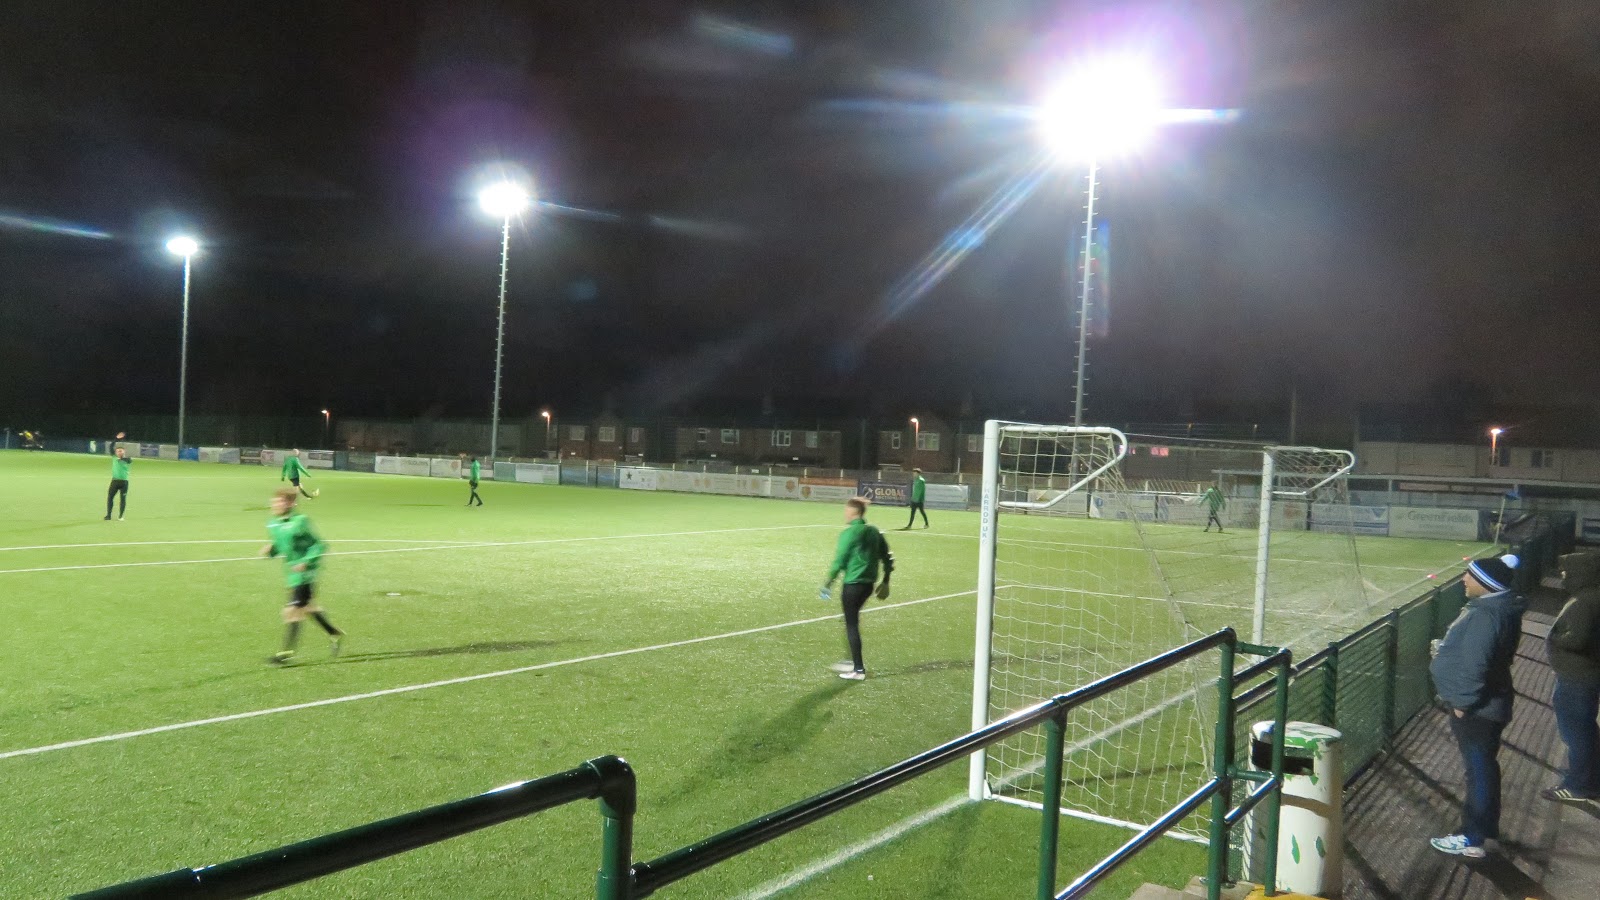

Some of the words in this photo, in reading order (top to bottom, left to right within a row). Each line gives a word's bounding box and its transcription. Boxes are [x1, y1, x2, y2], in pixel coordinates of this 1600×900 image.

[875, 488, 906, 497] GLOBAL
[982, 488, 990, 524] HARROD
[982, 526, 988, 538] UK
